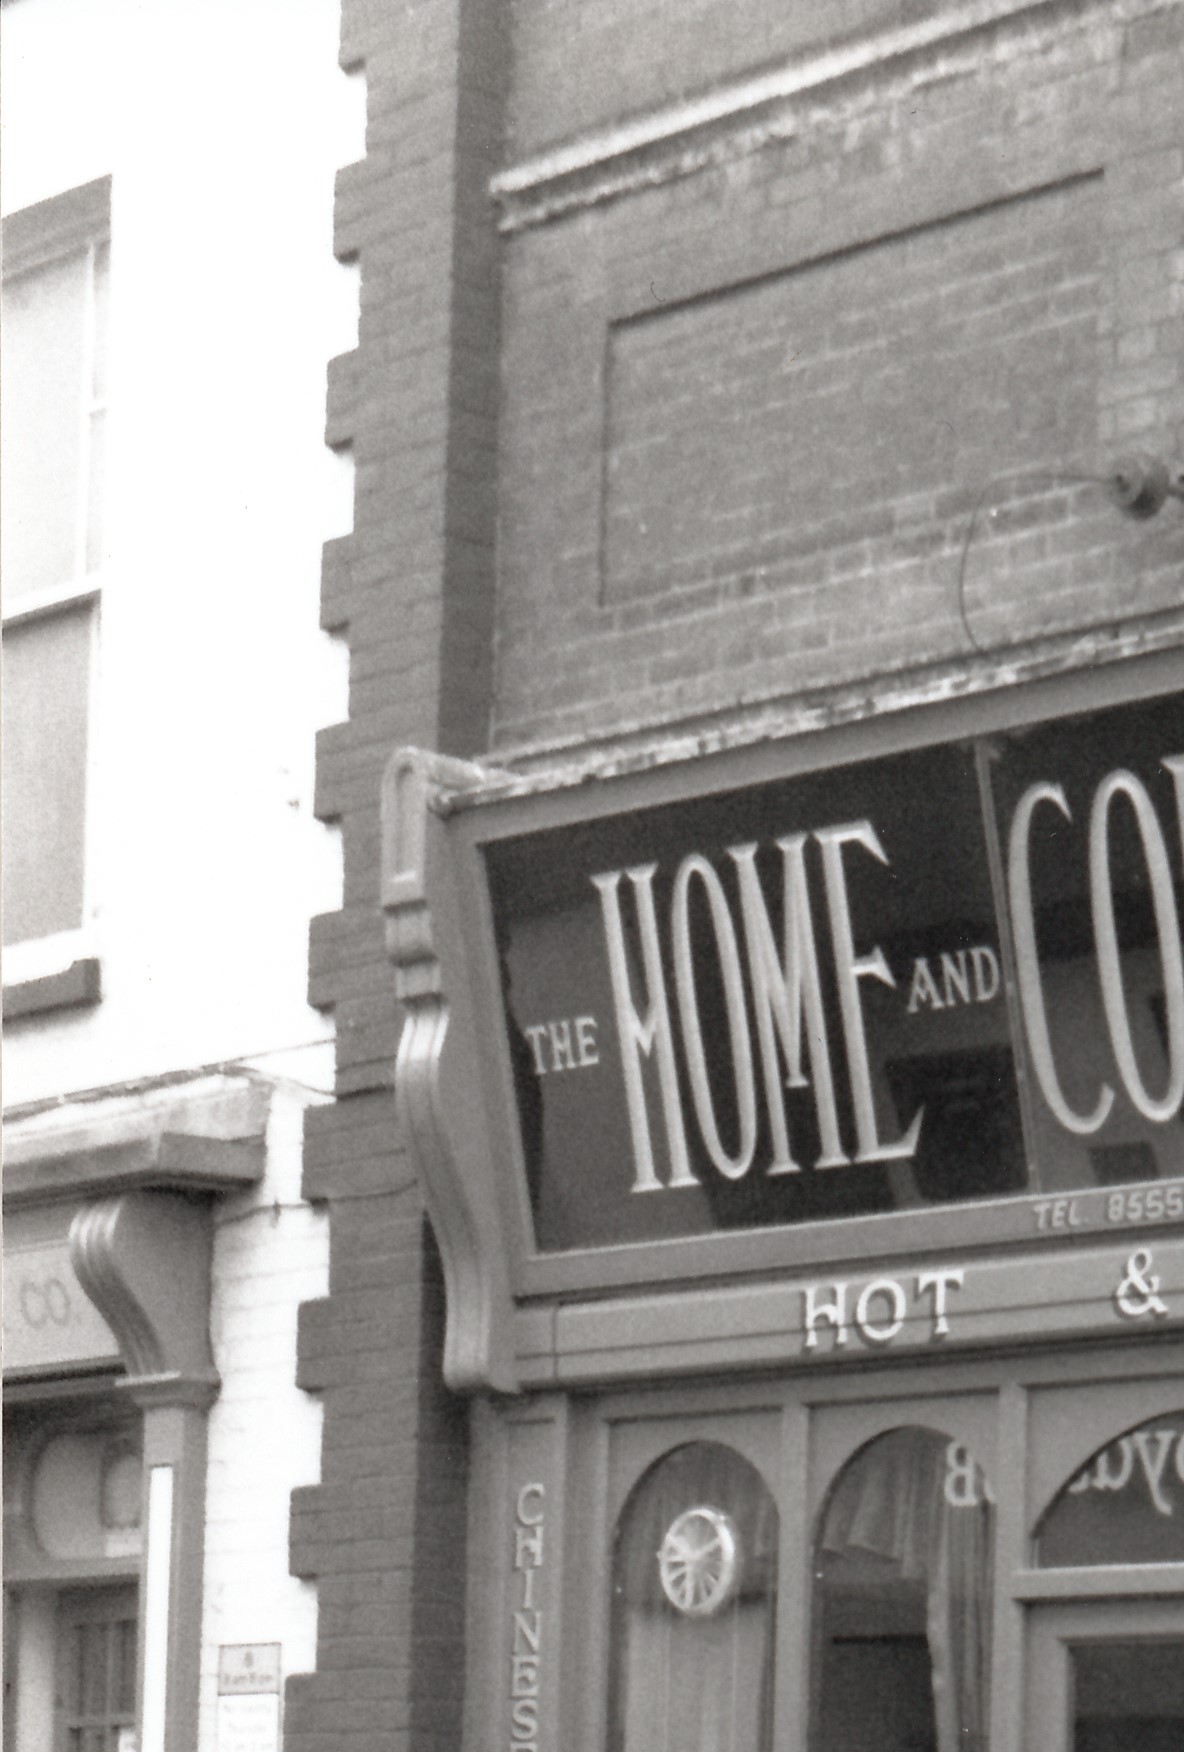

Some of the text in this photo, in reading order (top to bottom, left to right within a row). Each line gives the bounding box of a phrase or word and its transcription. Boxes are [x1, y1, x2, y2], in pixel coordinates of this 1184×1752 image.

[525, 1017, 599, 1075] THE
[591, 819, 925, 1193] HOME
[907, 947, 1000, 1013] AND
[804, 1271, 963, 1347] HOT
[1116, 1247, 1169, 1317] &
